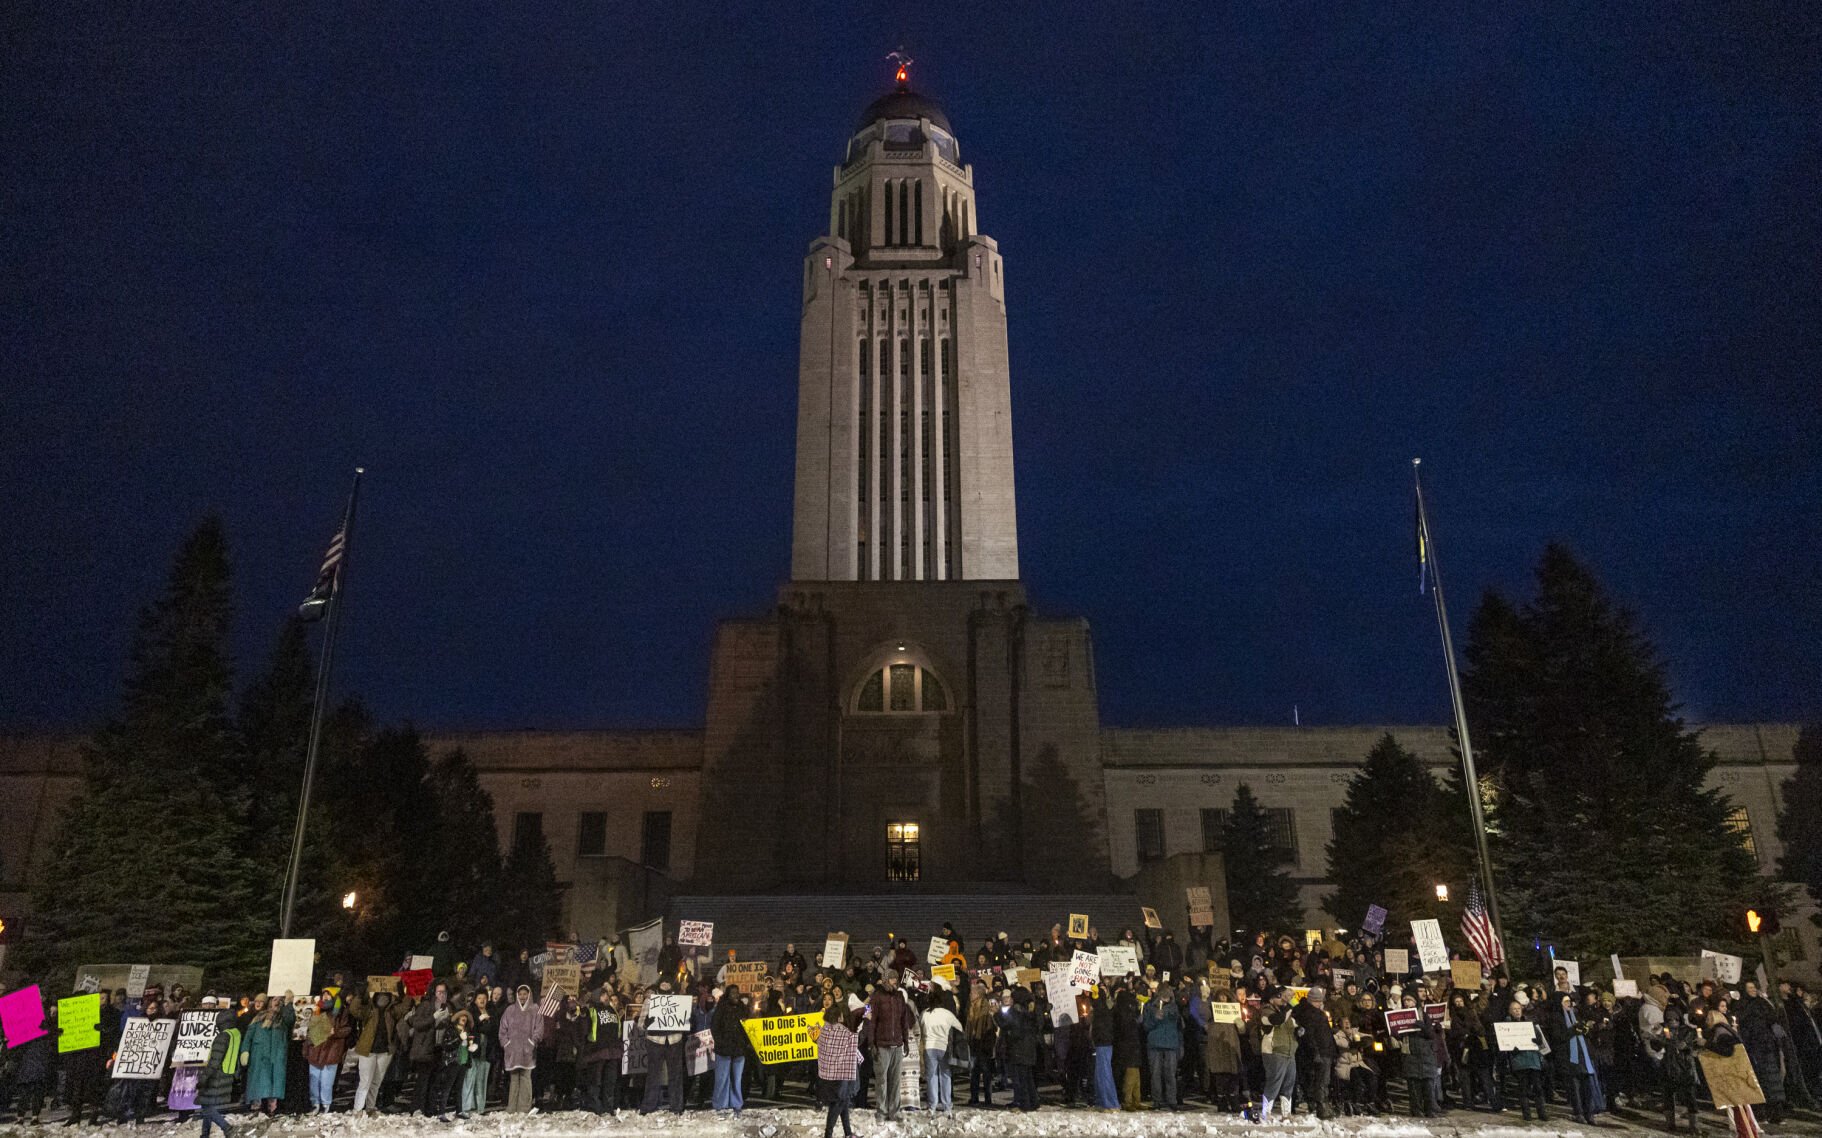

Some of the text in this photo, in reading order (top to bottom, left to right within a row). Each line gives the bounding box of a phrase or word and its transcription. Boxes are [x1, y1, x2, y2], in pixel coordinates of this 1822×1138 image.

[1086, 954, 1098, 964] ARE
[726, 963, 764, 973] NO ONE IS
[1079, 960, 1092, 970] NOT
[757, 972, 764, 982] ON
[977, 968, 992, 977] ICE
[750, 984, 765, 992] LAND
[650, 996, 677, 1009] ICE
[662, 1004, 680, 1015] OUT
[182, 1011, 196, 1021] ICE
[658, 1010, 687, 1029] NOW
[128, 1022, 171, 1032] I AM NOT
[762, 1016, 806, 1031] No One is
[180, 1022, 220, 1037] UNDER
[126, 1031, 168, 1040] DISTRACTED
[763, 1032, 807, 1046] Illegal on
[177, 1040, 212, 1049] PRESSURE
[120, 1050, 163, 1065] EPSTEIN
[758, 1046, 814, 1062] Stolen Land
[622, 1054, 648, 1069] POLIC
[117, 1062, 158, 1075] FILES!
